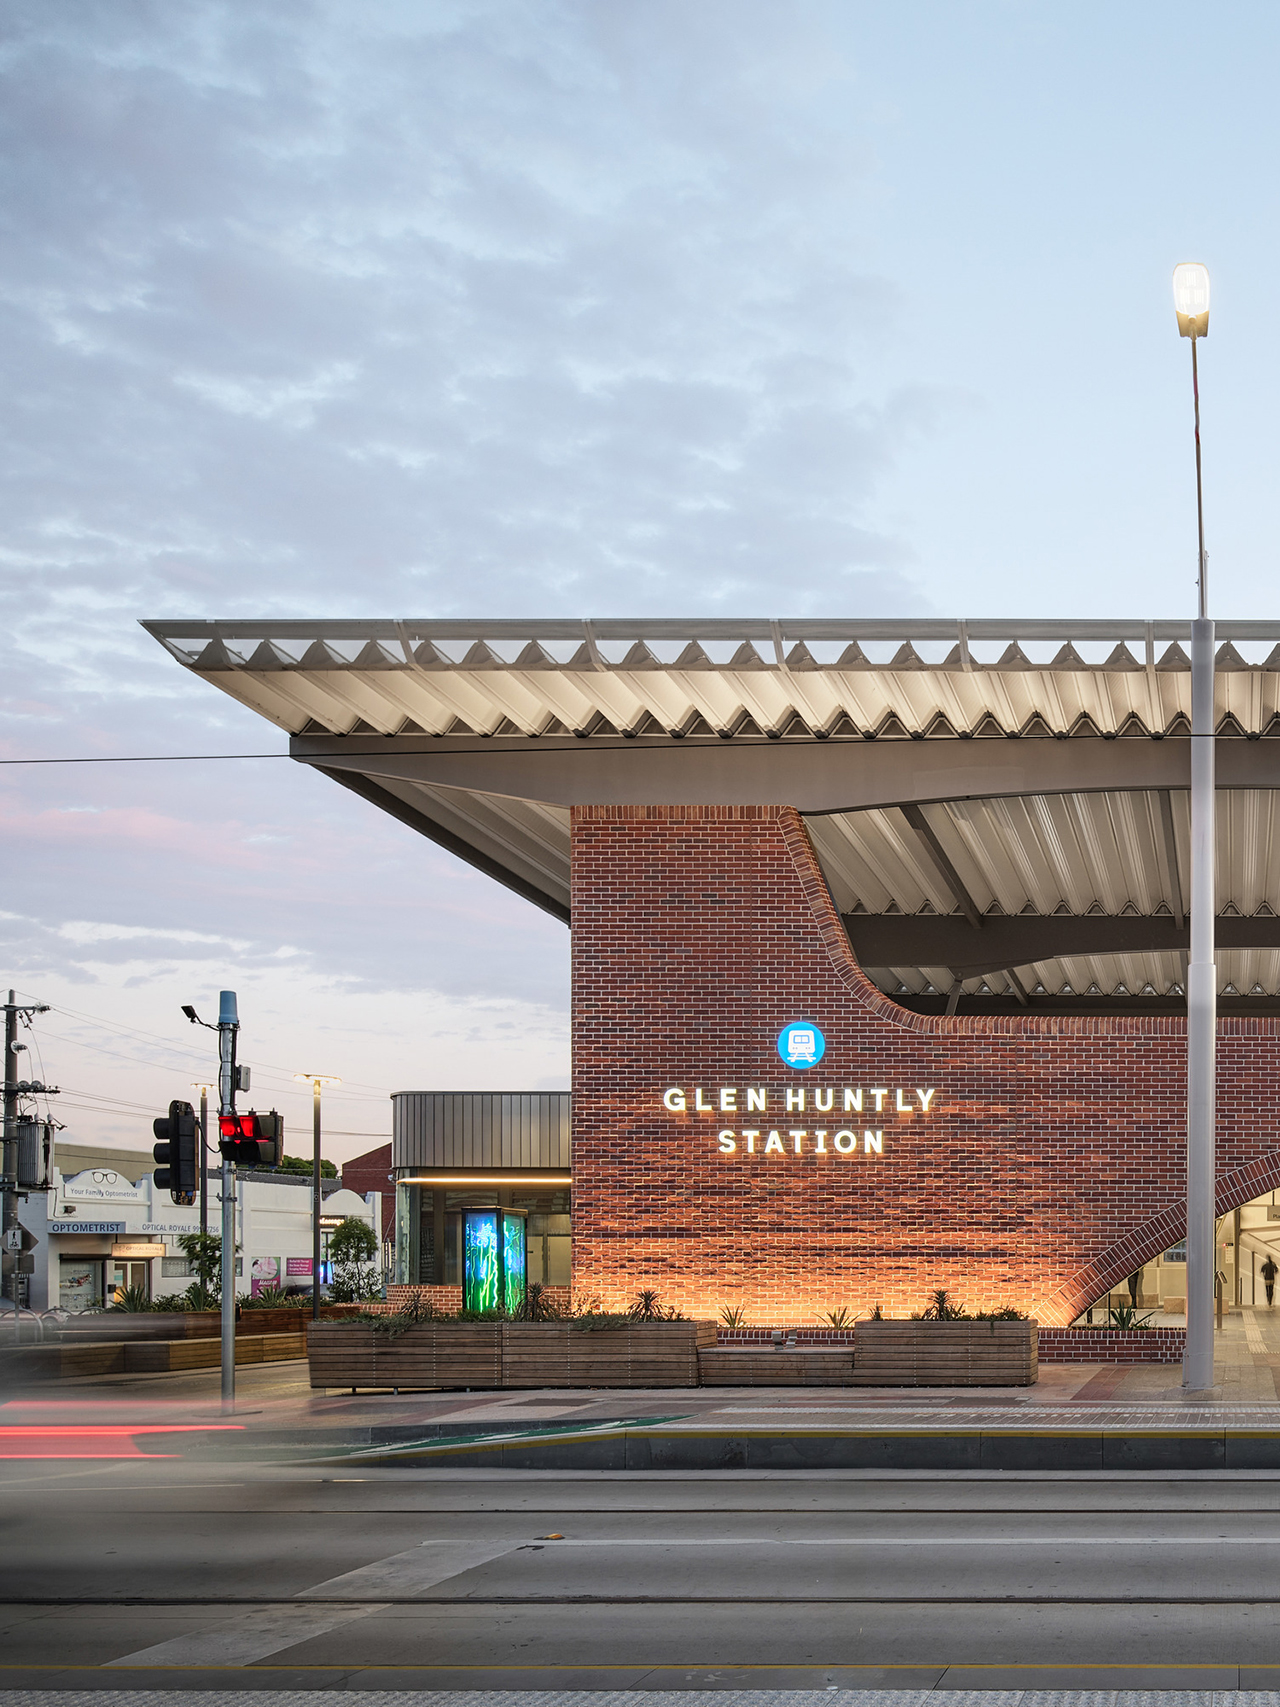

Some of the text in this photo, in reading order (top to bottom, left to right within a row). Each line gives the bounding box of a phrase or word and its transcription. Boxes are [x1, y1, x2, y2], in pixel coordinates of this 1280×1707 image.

[663, 1087, 935, 1112] GLEN HUNTLY
[718, 1129, 883, 1154] STATION
[85, 1188, 104, 1197] Family
[104, 1189, 138, 1198] Optometrist
[52, 1223, 121, 1233] OPTOMETRIST
[142, 1223, 167, 1231] OPTICAL
[168, 1224, 191, 1232] ROYALE
